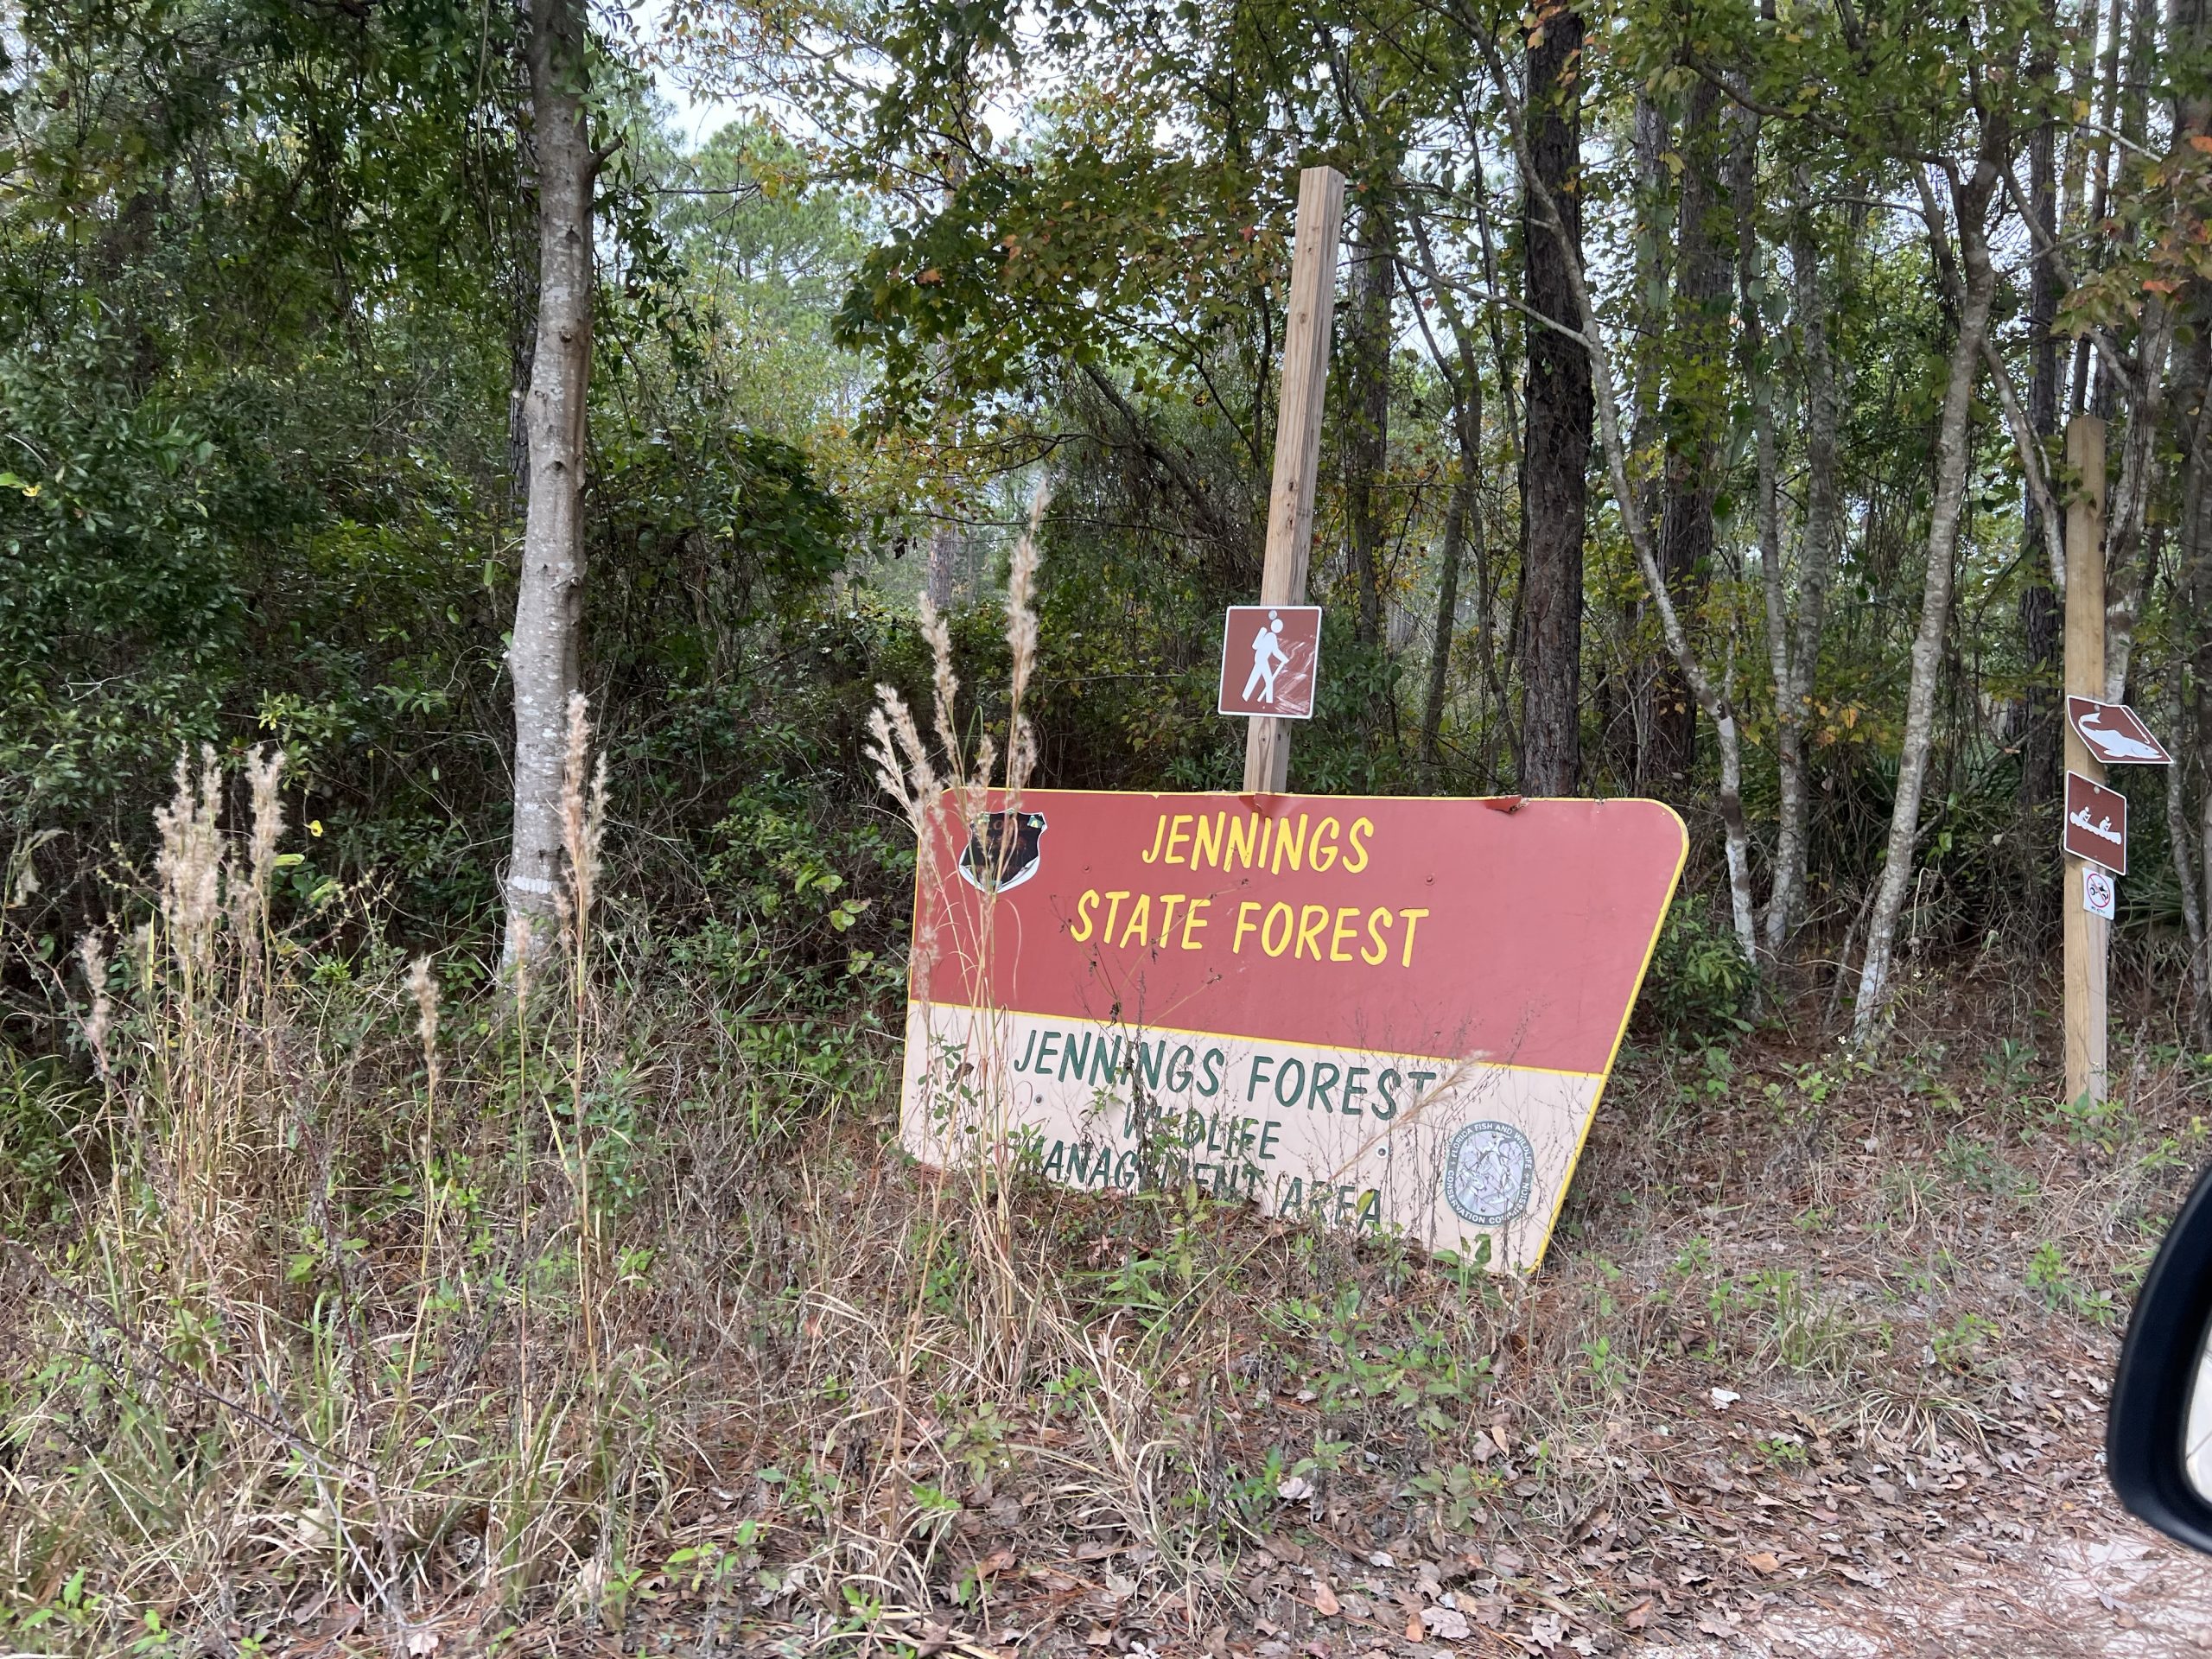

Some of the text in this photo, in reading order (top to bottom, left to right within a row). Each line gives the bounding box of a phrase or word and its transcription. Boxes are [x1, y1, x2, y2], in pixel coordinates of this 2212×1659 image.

[1142, 810, 1374, 874] JENNINGS
[1071, 889, 1430, 968] STATE FOREST
[1248, 1055, 1436, 1121] FOREST
[1123, 1103, 1281, 1160] WDLIFE
[1452, 1128, 1473, 1158] FLORIDA
[1495, 1124, 1513, 1135] AND
[1514, 1133, 1532, 1170] WILDLIFE
[1021, 1135, 1381, 1233] ANAGENT AREA
[1446, 1170, 1486, 1224] CONSERVATION
